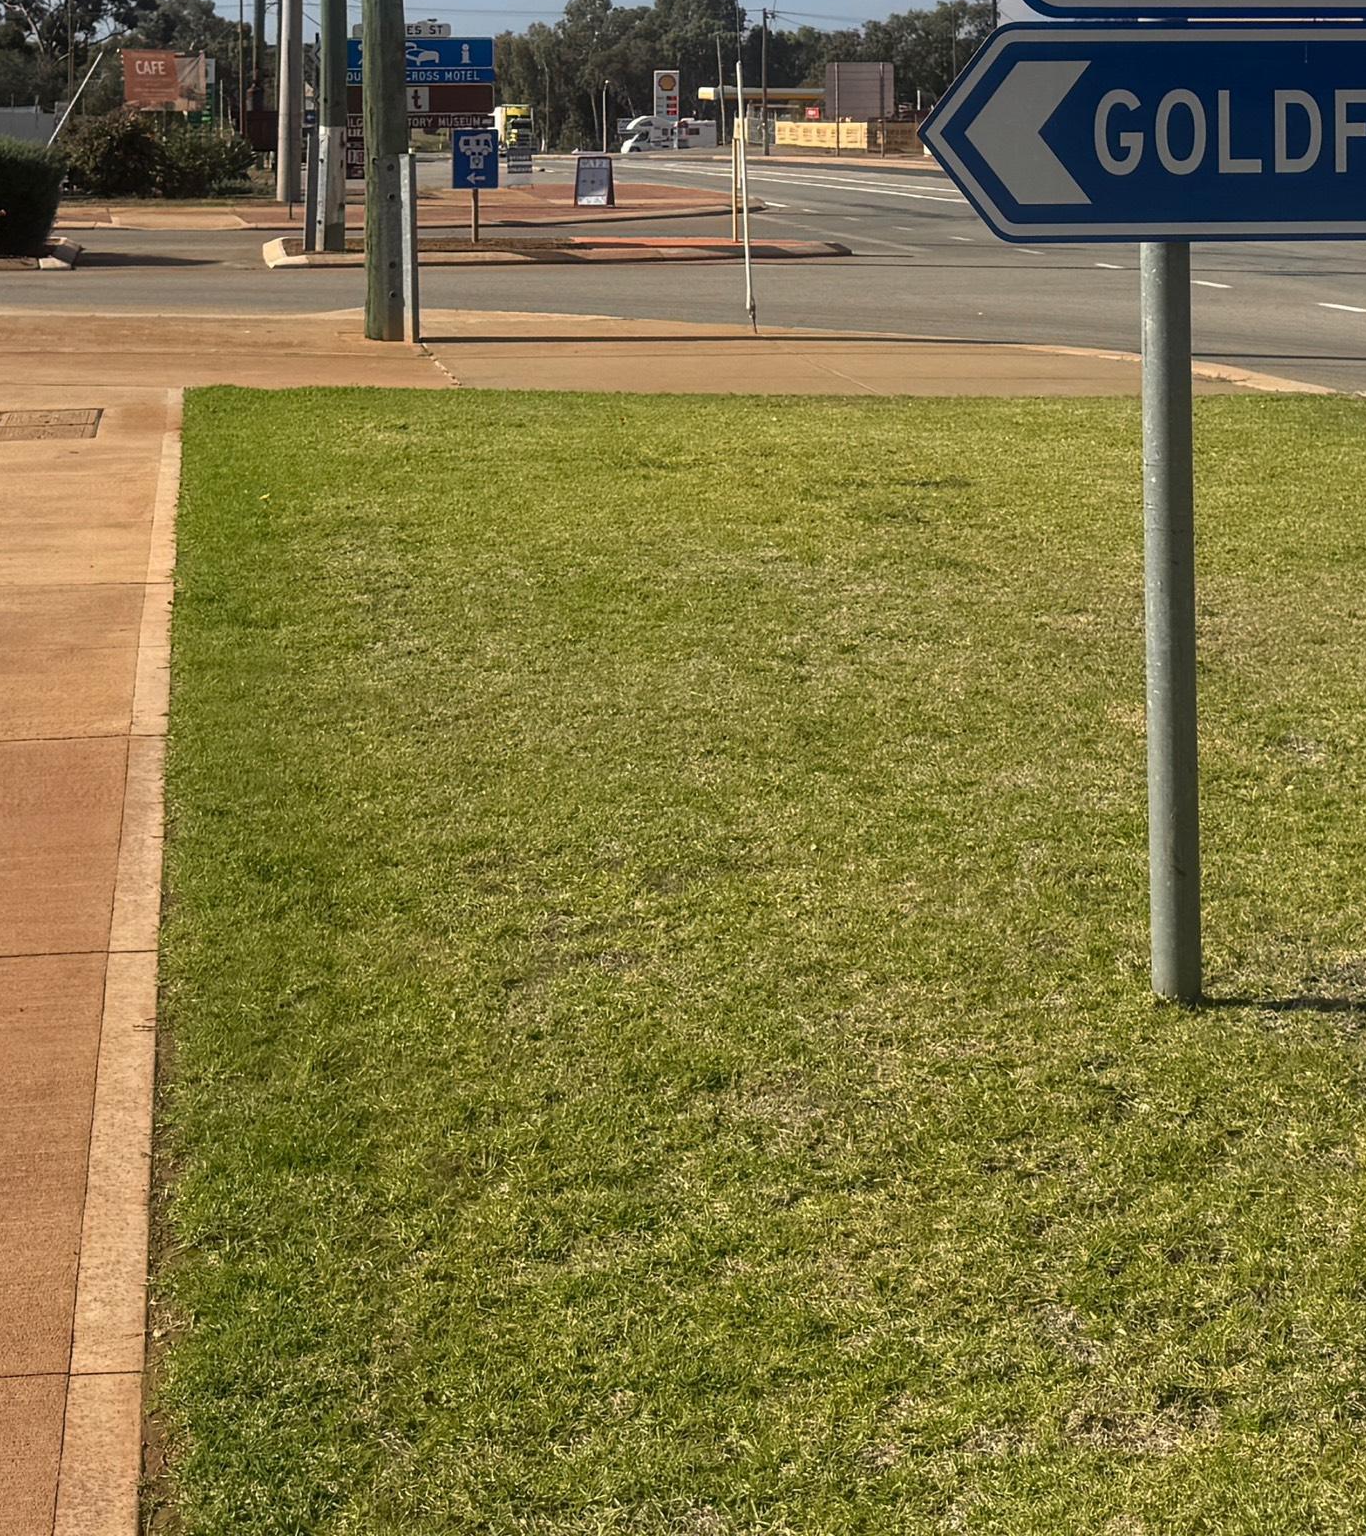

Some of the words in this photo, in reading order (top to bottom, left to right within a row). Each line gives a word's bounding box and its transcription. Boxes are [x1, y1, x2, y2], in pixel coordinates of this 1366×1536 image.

[429, 25, 444, 35] ST
[136, 60, 167, 75] CAFE
[444, 71, 481, 81] MOTEL
[438, 115, 481, 127] MUSEUM
